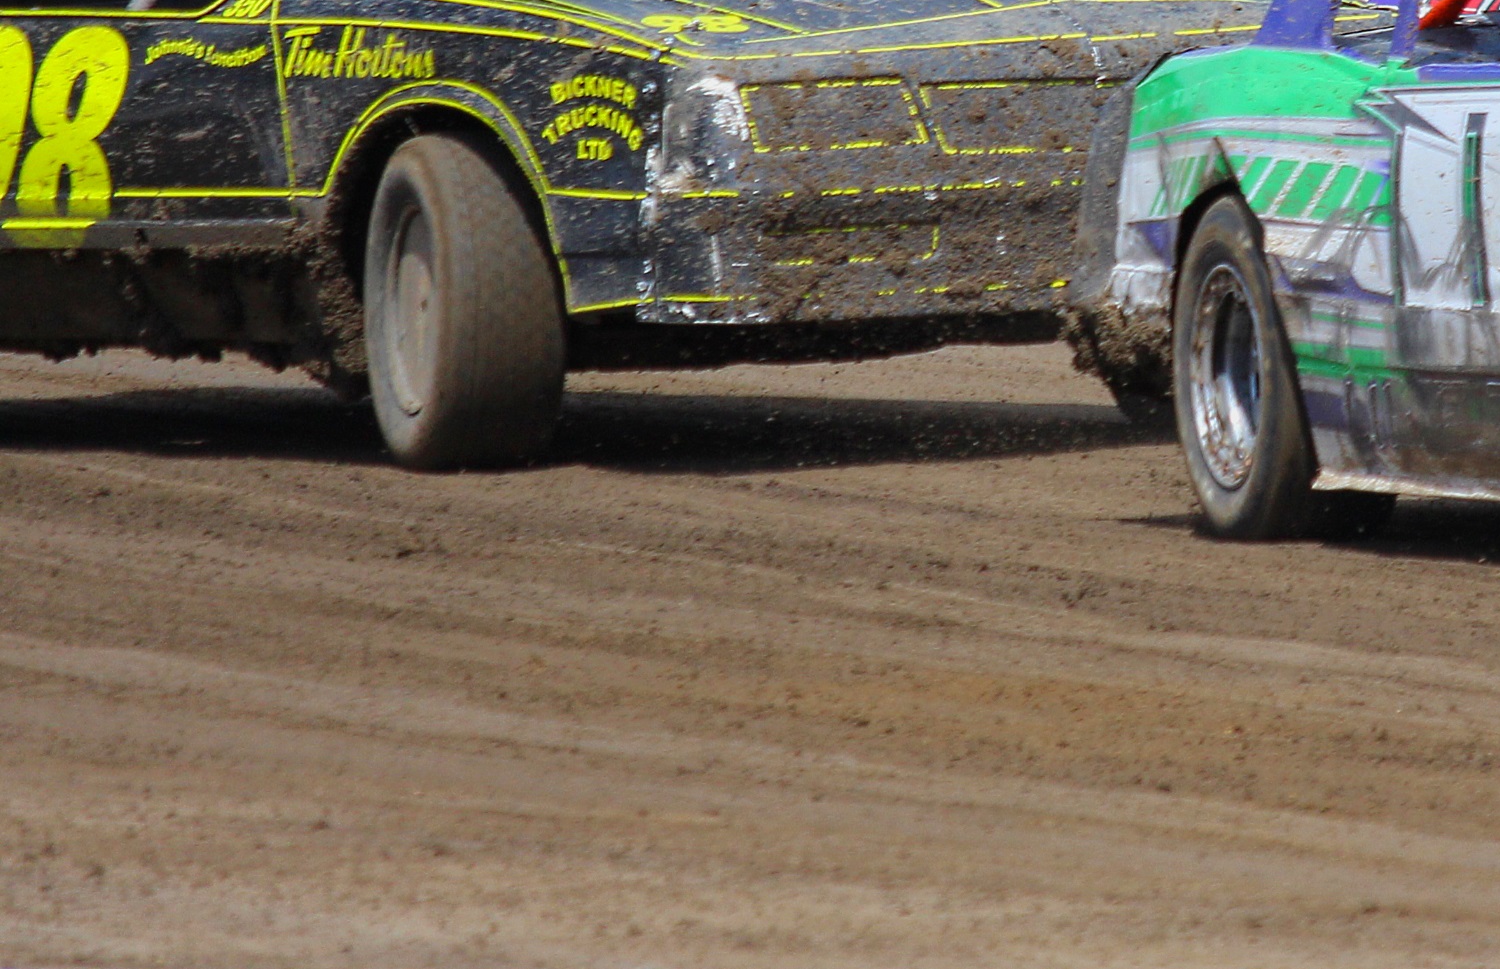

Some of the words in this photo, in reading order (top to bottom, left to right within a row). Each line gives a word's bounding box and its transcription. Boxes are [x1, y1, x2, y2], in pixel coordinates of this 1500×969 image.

[284, 25, 333, 79] Tim
[332, 25, 435, 79] Hortons
[549, 74, 637, 110] BICKNER
[541, 104, 644, 151] TRUCKING
[576, 136, 614, 161] LTD
